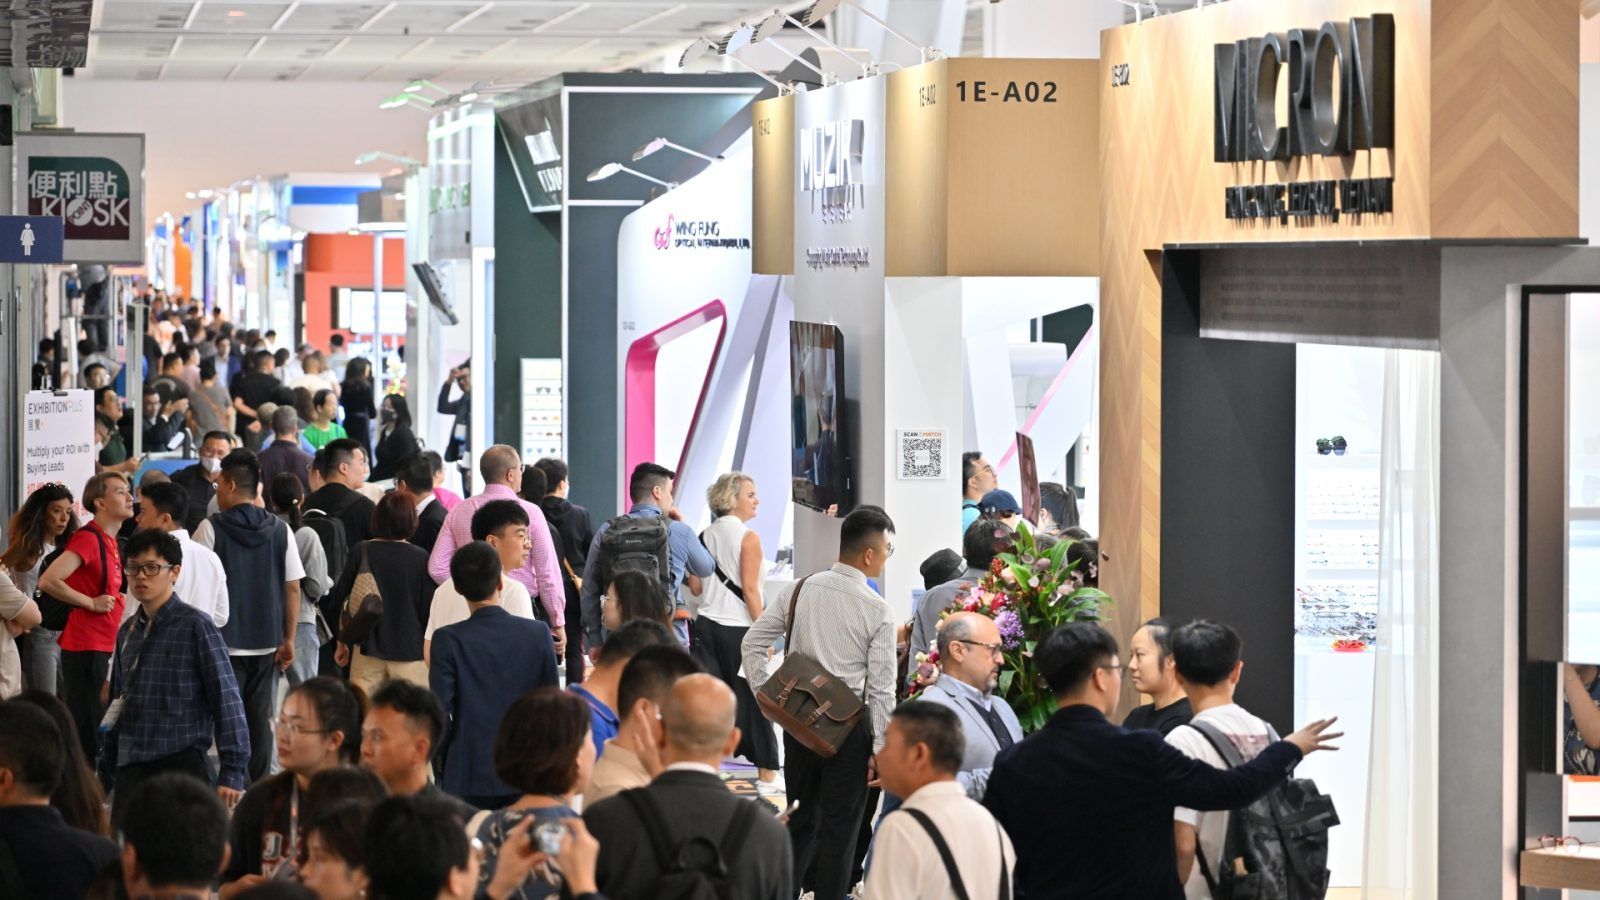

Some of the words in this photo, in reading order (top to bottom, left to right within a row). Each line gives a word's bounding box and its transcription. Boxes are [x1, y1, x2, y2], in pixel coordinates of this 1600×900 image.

[956, 81, 1057, 102] 1E-A02
[1214, 13, 1395, 163] MICRON
[800, 119, 864, 192] MUZIK
[28, 169, 118, 199] 便利點
[41, 197, 130, 227] KIOSK
[675, 221, 697, 236] WING
[698, 221, 720, 236] FUNG
[27, 446, 50, 459] Multiply
[51, 446, 64, 458] your
[65, 444, 76, 454] ROI
[77, 444, 90, 454] with
[27, 463, 47, 476] Buying
[47, 462, 64, 473] Leads
